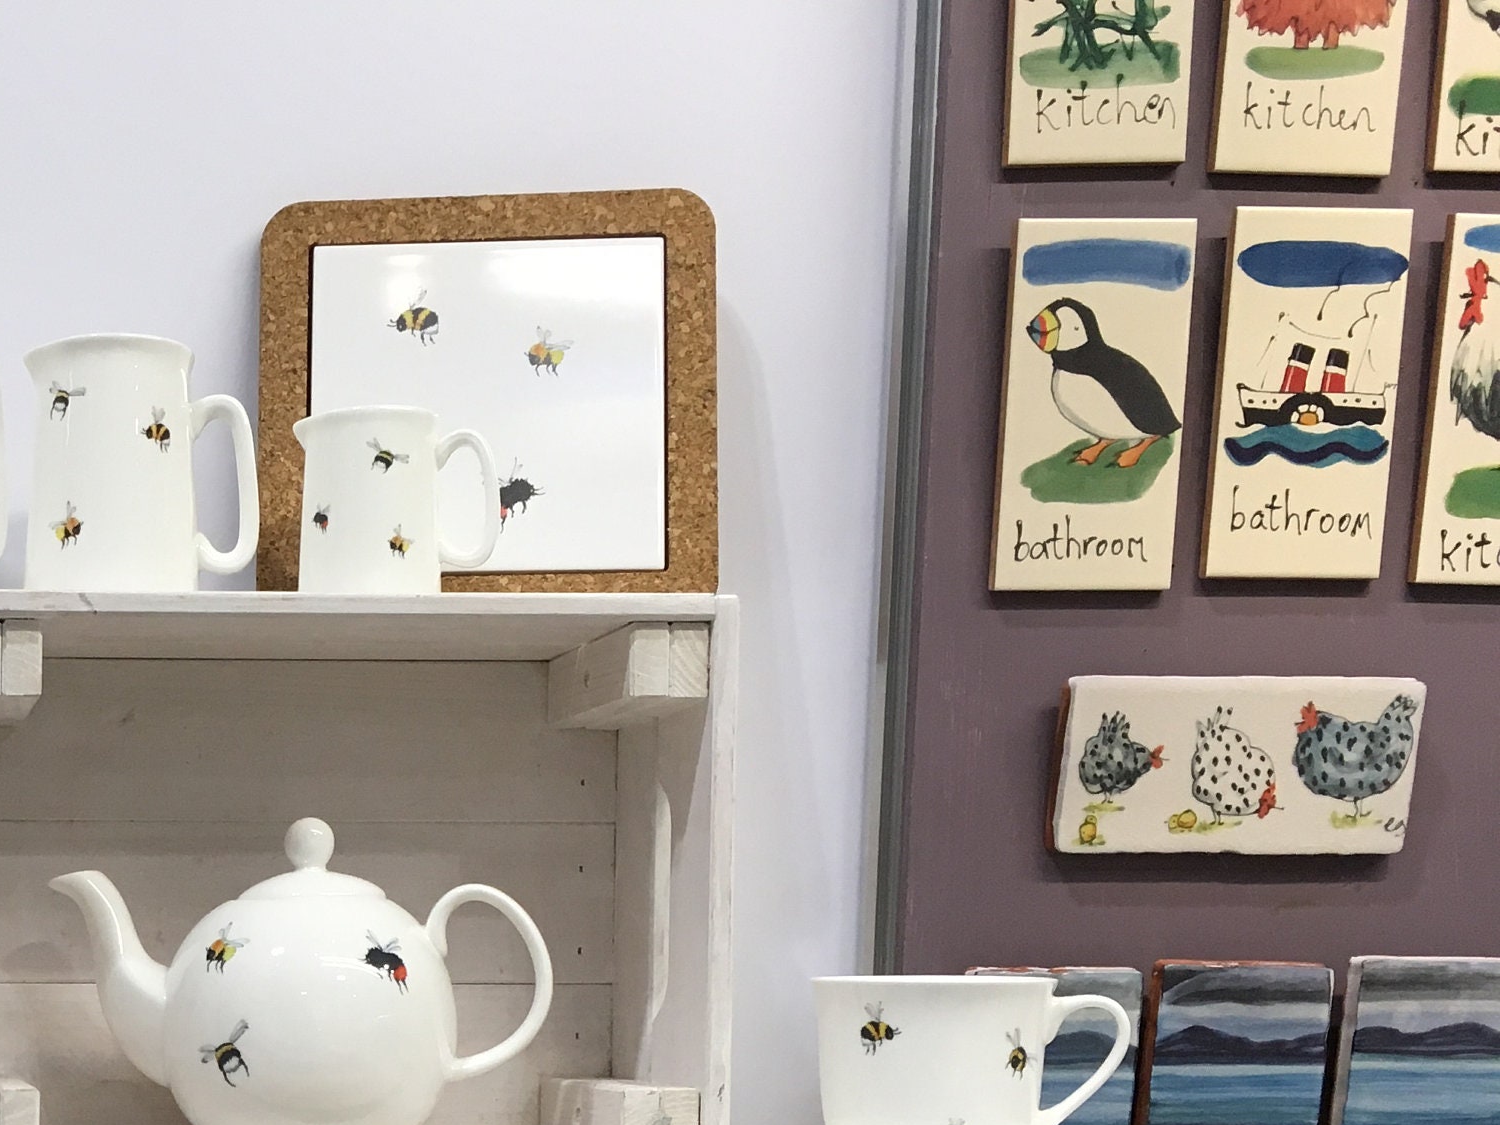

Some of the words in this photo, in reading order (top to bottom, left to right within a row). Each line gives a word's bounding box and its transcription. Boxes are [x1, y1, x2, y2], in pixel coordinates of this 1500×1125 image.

[1035, 73, 1177, 134] kitchen
[1243, 82, 1377, 133] kitchen
[1455, 99, 1500, 156] ki
[1229, 485, 1373, 537] bathroom
[1012, 515, 1148, 564] bathroom
[1440, 529, 1500, 572] kit
